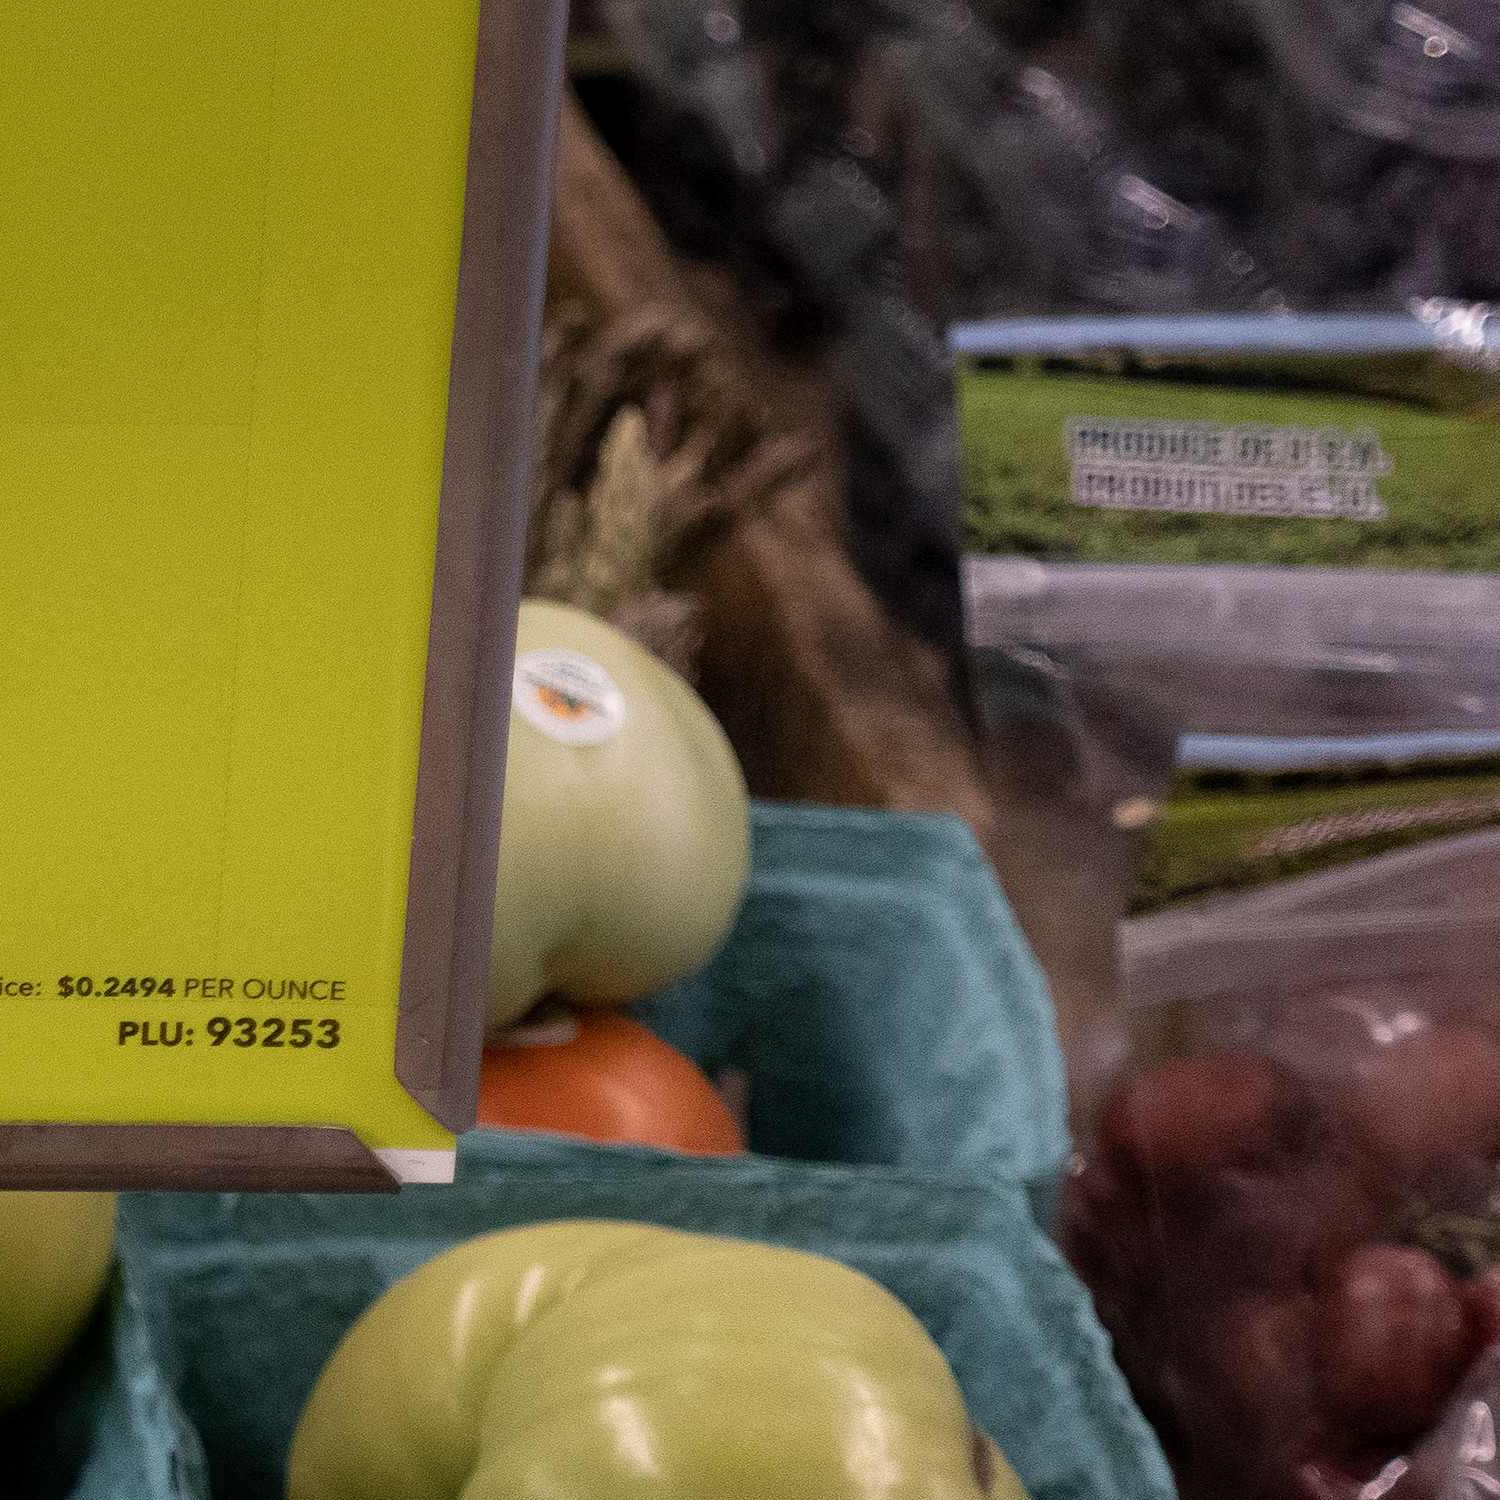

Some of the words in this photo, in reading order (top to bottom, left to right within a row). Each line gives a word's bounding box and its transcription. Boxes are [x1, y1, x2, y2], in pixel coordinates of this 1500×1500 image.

[57, 975, 177, 999] $0.2494
[183, 977, 235, 1000] PER
[242, 977, 346, 1002] OUNCE
[118, 1019, 194, 1048] PLU:
[206, 1016, 342, 1050] 93253
